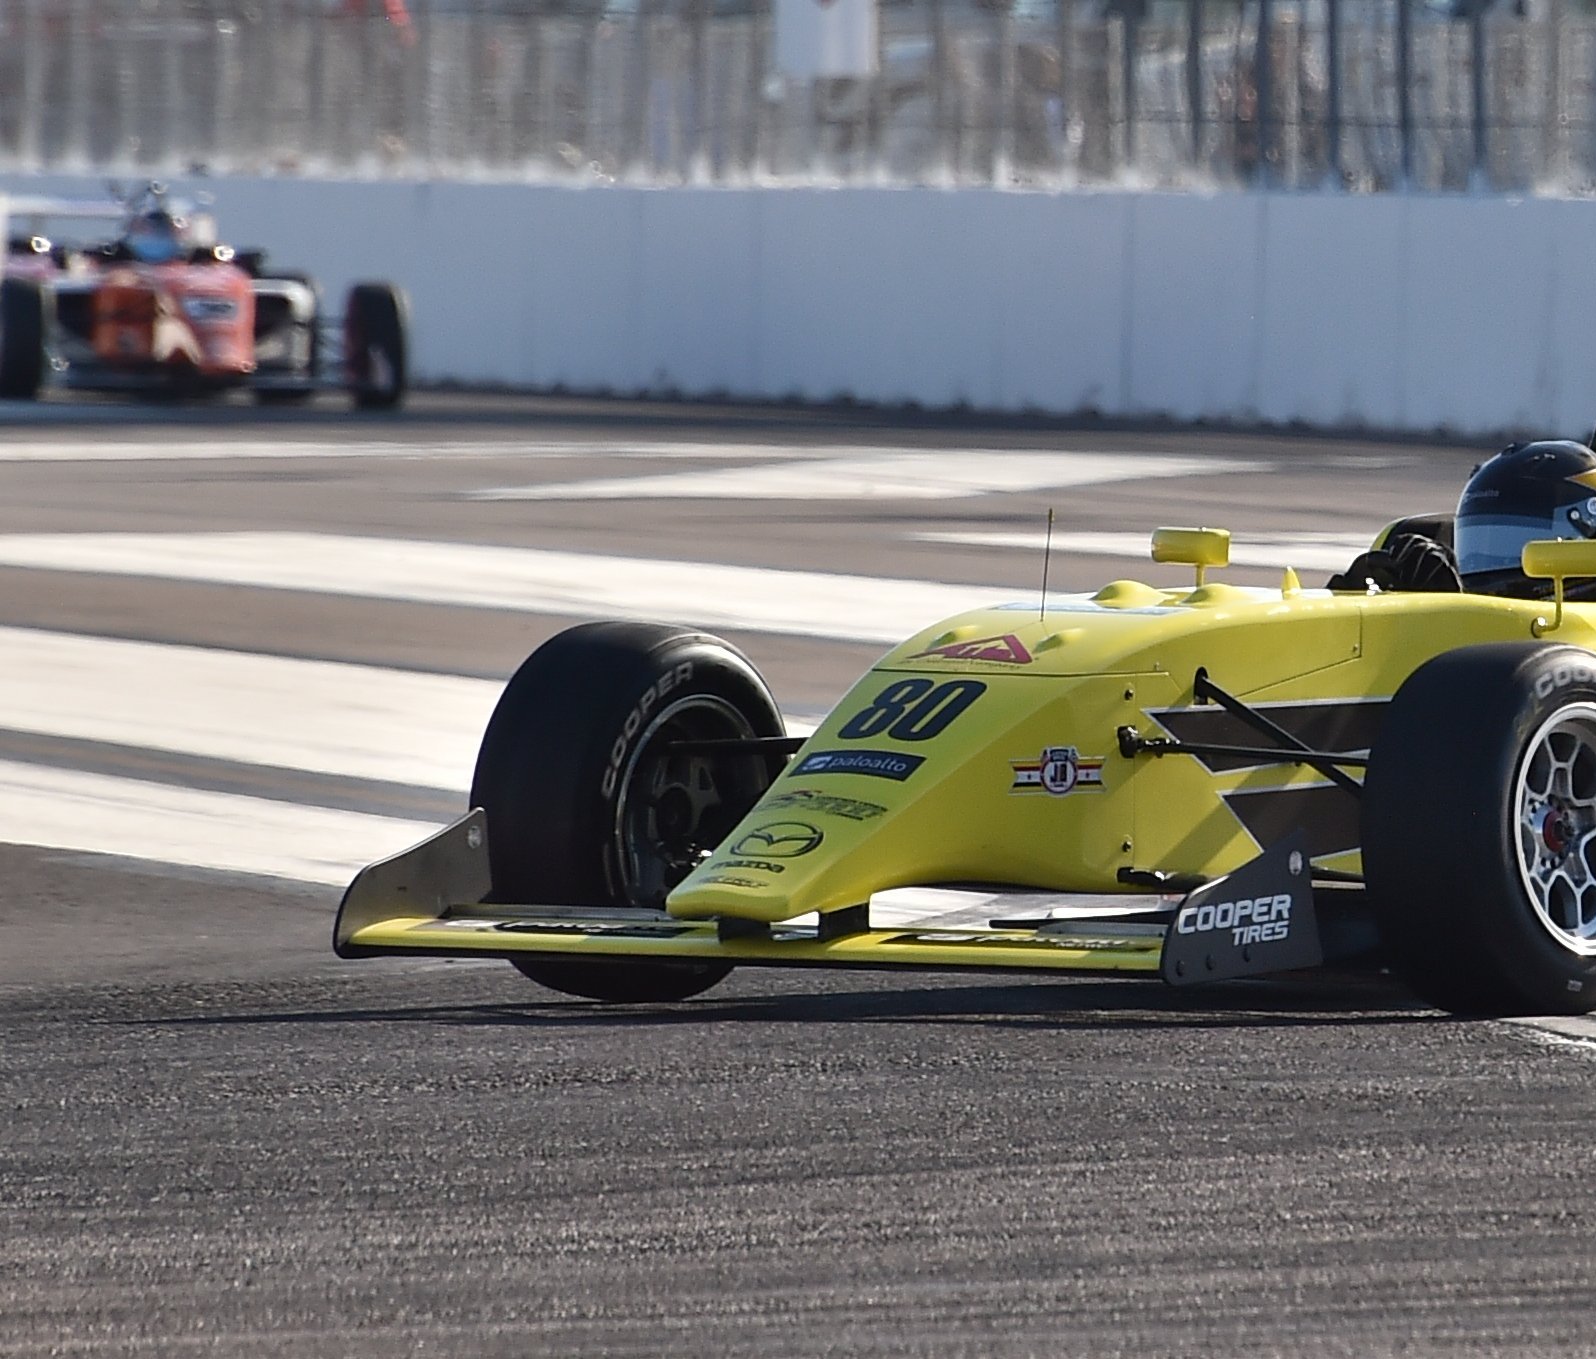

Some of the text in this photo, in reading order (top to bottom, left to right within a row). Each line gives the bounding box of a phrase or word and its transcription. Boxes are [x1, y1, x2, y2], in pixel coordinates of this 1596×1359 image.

[837, 678, 988, 741] 80
[602, 661, 693, 799] COOPER
[828, 756, 907, 772] paloalto
[1178, 894, 1291, 934] COOPER
[1232, 920, 1289, 946] TIRES
